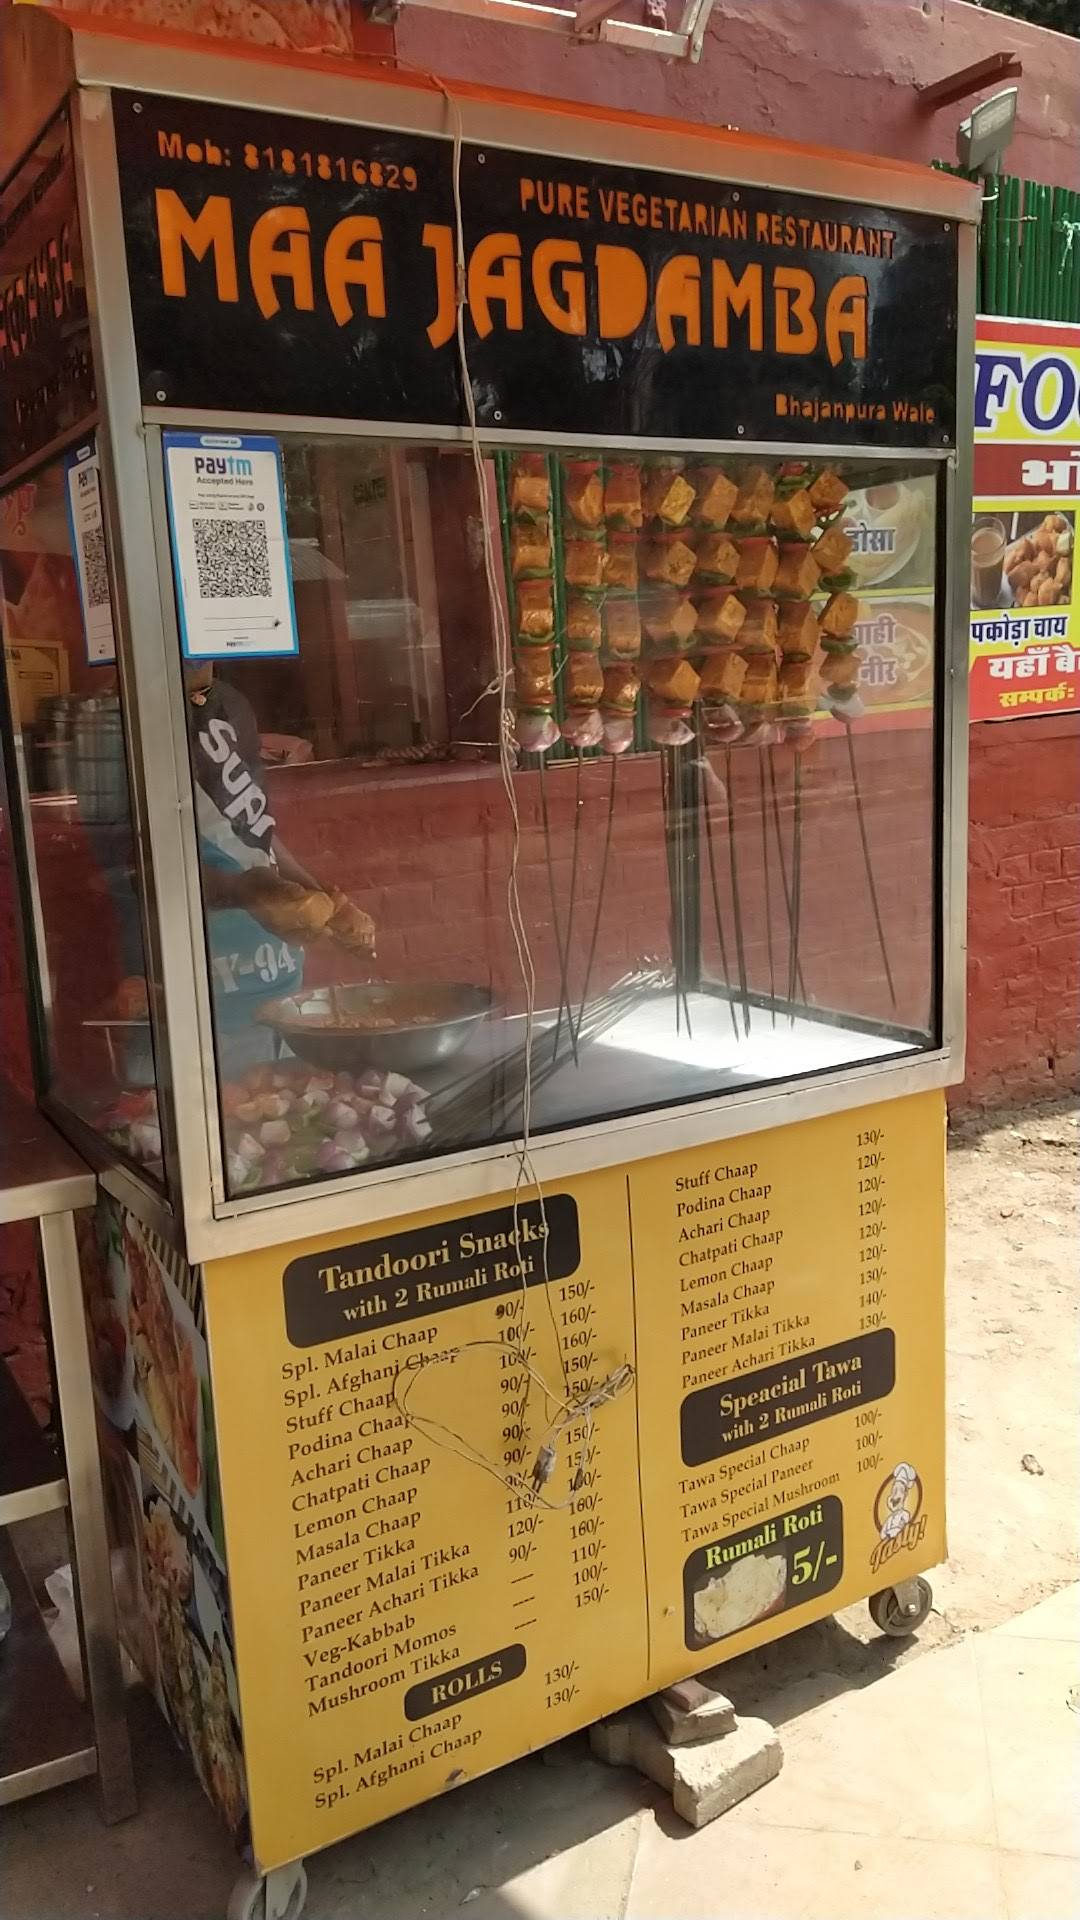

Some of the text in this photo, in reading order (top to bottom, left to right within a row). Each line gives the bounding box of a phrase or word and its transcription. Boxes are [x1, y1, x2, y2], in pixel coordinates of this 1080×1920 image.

[157, 130, 418, 192] Mob: 8181816829
[519, 177, 896, 260] PURE VEGETARIAN RESTAURANT
[155, 188, 386, 328] MAA
[421, 222, 869, 368] JAGDAMBA
[775, 393, 936, 425] Bhajanpura Wale
[975, 355, 1080, 431] FO
[197, 477, 254, 487] Accepted Here
[988, 647, 1050, 679] यहाँ
[1034, 615, 1067, 639] चाय
[676, 1129, 885, 1191] Stuff Chaap 130/-
[677, 1152, 886, 1217] Podina Chaap 120/-
[679, 1176, 886, 1242] Achari Chaap 120/-
[679, 1198, 887, 1266] Chatpati Chaap 120/-
[319, 1218, 550, 1293] Tandoori Snacks
[344, 1256, 533, 1320] with 2 Rumali Roti
[680, 1221, 887, 1292] Lemon Chaap 120/-
[681, 1244, 887, 1316] Masala Chaap 120/-
[282, 1280, 596, 1381] Spl. Malai Chaap 90/- 150/-
[682, 1267, 887, 1341] Paneer Tikka 130/-
[683, 1290, 887, 1364] Paneer Malai Tikka 140/-
[284, 1305, 597, 1408] Spl. Afghani Chaap 100/- 160/-
[287, 1405, 333, 1433] Stuff
[340, 1391, 396, 1417] Chaap
[562, 1328, 597, 1351] 160/-
[682, 1312, 887, 1390] Paneer Achari Tikka 130/-
[721, 1357, 861, 1418] Speacial Tawa
[289, 1352, 599, 1460] Podina Chaap 90/- 150/-
[291, 1376, 598, 1486] Achari Chaap 90/- 150/-
[722, 1381, 860, 1441] with 2 Rumali Roti
[292, 1424, 531, 1511] Chatpati Chaap 90/-
[294, 1422, 600, 1538] Lemon Chaap 90/- 150/-
[678, 1411, 882, 1494] Tawa Special Chaap 100/-
[680, 1430, 883, 1518] Tawa Special Paneer 100/-
[298, 1559, 358, 1591] Paneer
[364, 1540, 414, 1565] Tikka
[568, 1469, 602, 1491] 10/-
[681, 1454, 884, 1542] Tawa Special Mushroom 100/-
[296, 1532, 360, 1565] Masala
[366, 1512, 420, 1538] Chaap
[300, 1492, 603, 1617] Paneer Malai Tikka 120/- 160/-
[705, 1505, 822, 1570] Rumali Roti
[792, 1541, 838, 1586] 5/-
[302, 1516, 605, 1643] Paneer Achari Tikka 90/- 160/-
[304, 1540, 607, 1666] Veg-Kabbab 110/-
[305, 1562, 609, 1692] Tandoori Momos 100/-
[308, 1584, 610, 1717] Mushroom Tikka 150/-
[433, 1662, 501, 1703] ROLLS
[314, 1660, 580, 1783] Spl. Malai Chaap 130/-
[316, 1685, 581, 1808] Spl. Afghani Chaap 130/-
